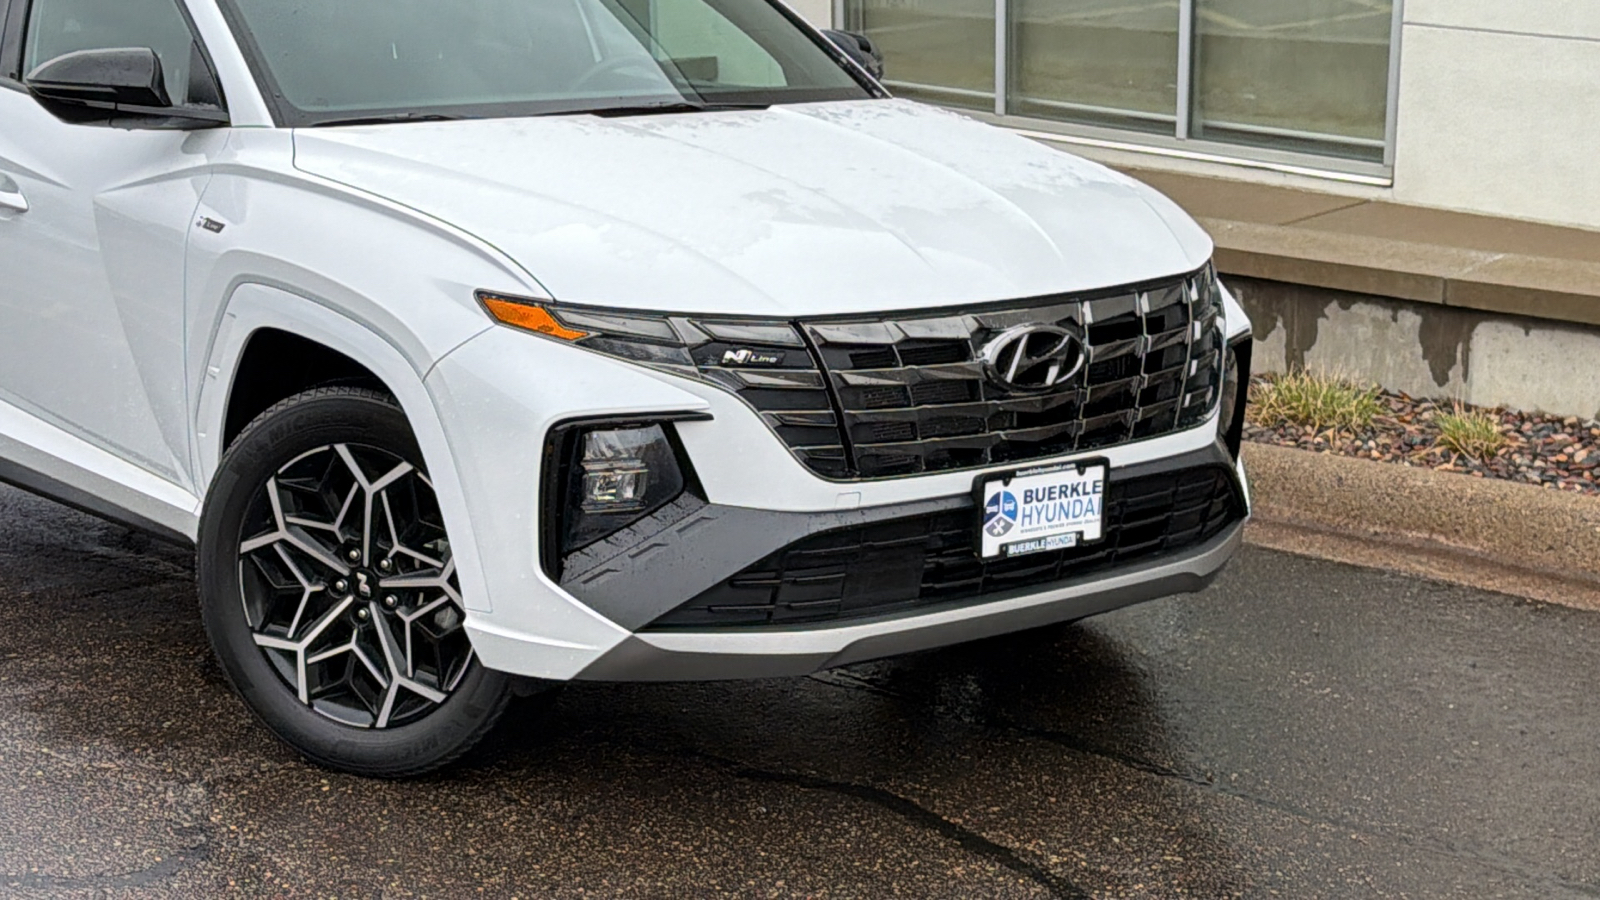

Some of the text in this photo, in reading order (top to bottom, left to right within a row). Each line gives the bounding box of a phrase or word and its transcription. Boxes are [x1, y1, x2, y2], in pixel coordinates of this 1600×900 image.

[751, 355, 777, 363] Line
[1024, 480, 1102, 504] BUERKLE
[1021, 497, 1102, 527] HYUNDAI
[1008, 539, 1046, 554] BUERKLE
